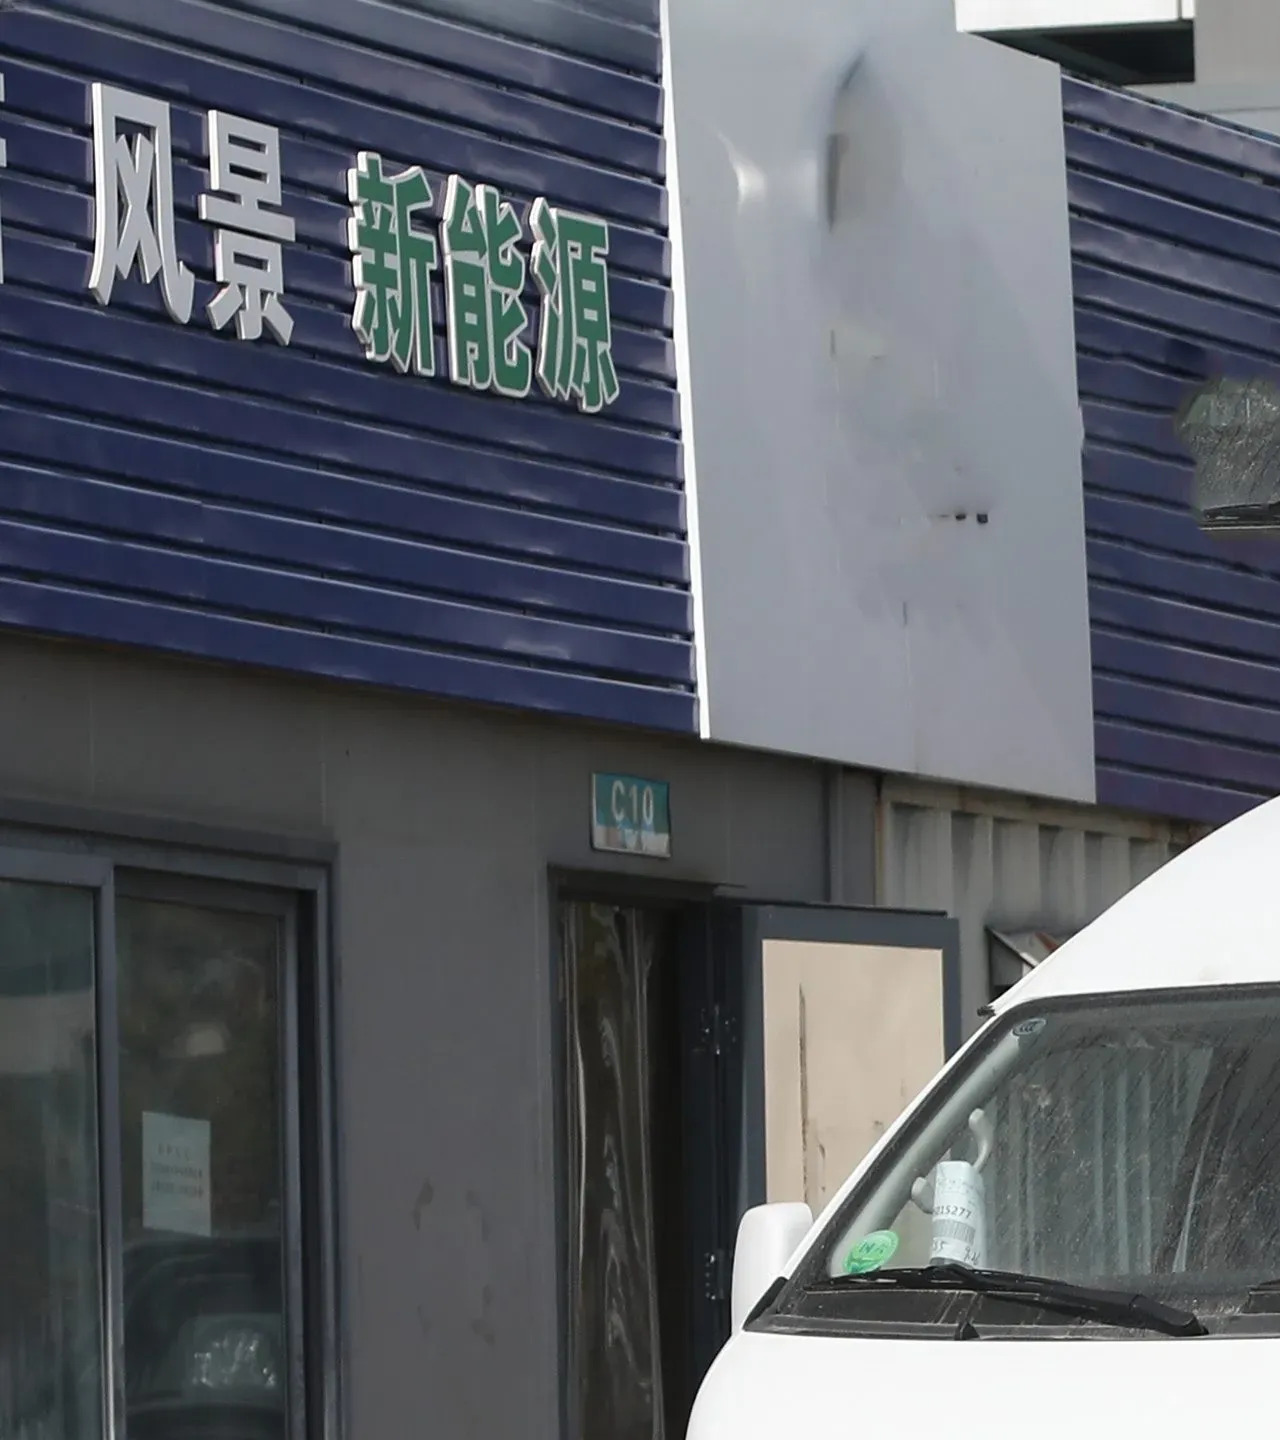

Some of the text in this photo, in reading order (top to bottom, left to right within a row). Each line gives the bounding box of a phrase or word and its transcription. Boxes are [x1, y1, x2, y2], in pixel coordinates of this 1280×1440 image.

[88, 80, 296, 346] 风景
[346, 150, 619, 413] 新能源
[611, 779, 654, 825] C10
